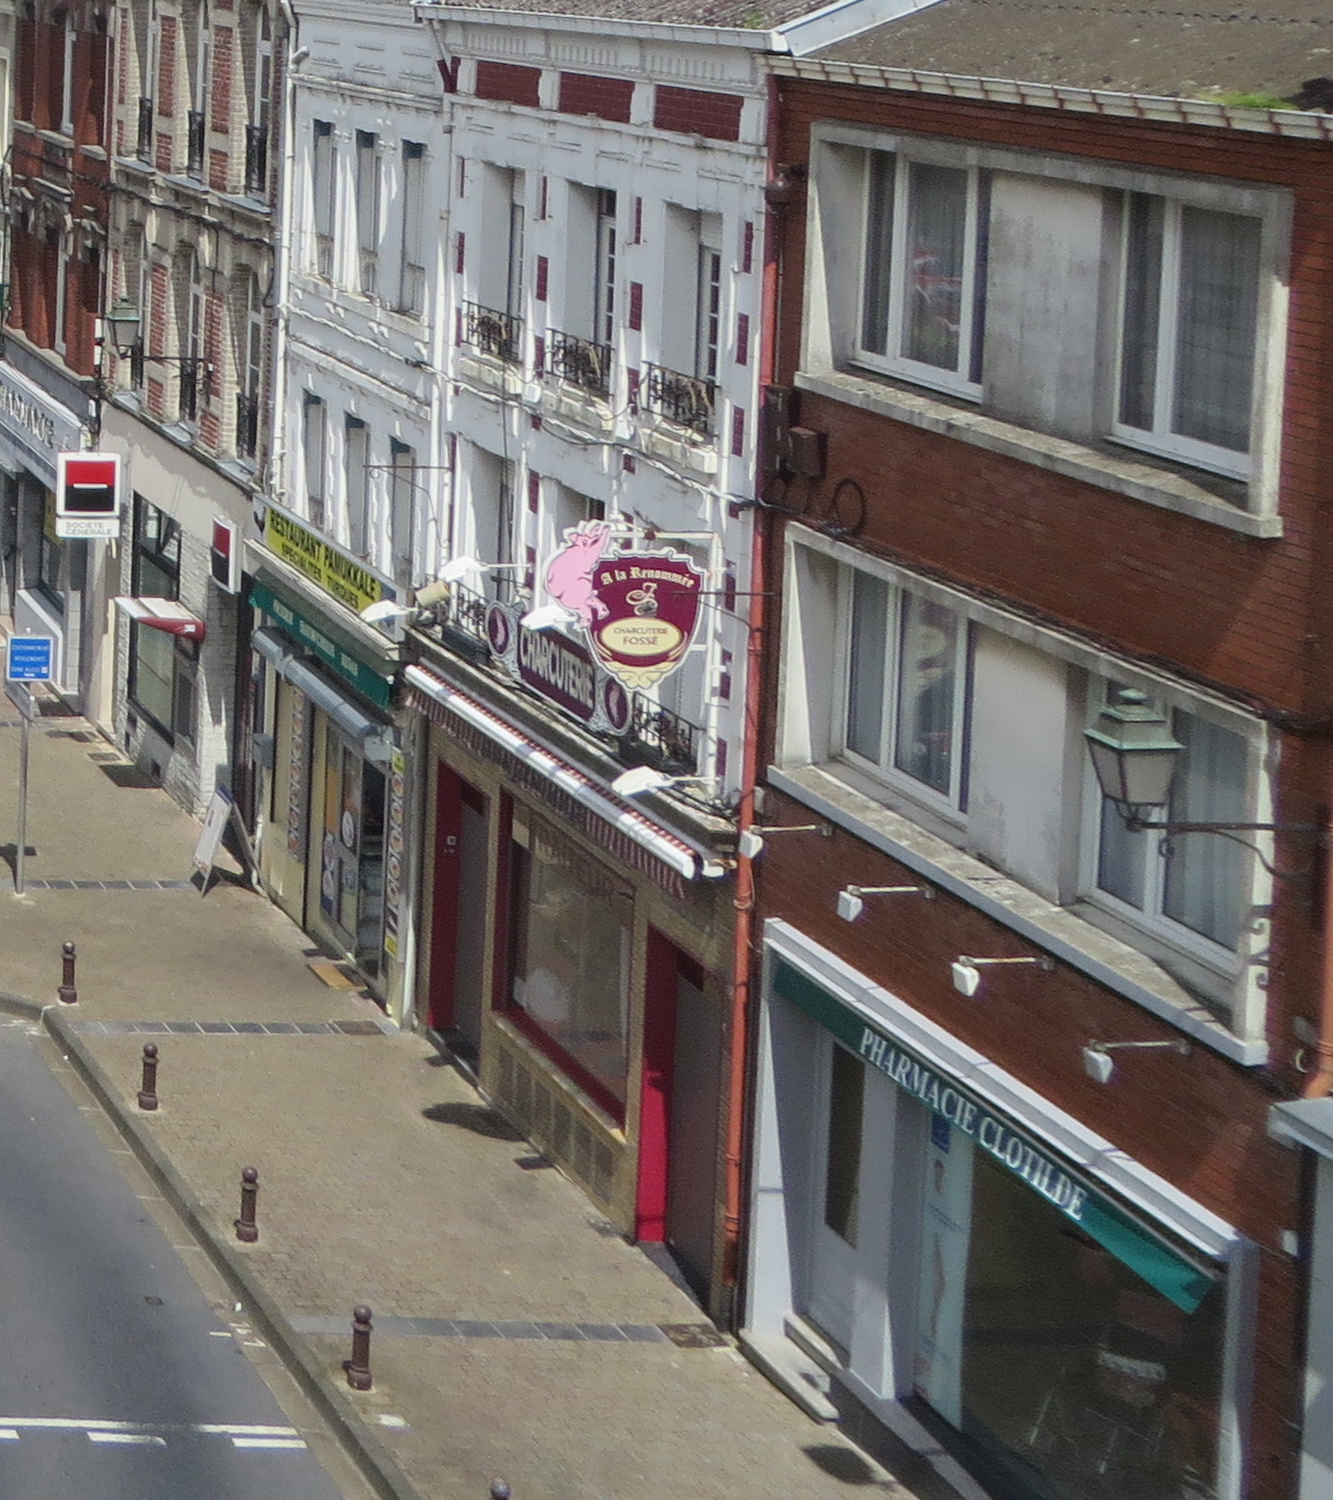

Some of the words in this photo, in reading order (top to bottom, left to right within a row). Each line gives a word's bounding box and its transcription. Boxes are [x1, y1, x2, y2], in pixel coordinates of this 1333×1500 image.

[270, 506, 322, 563] RESTAURANT
[613, 627, 668, 636] CHARCUTERIE
[520, 626, 595, 710] CHARCUTERIE
[860, 1027, 978, 1134] PHARMACIE
[979, 1116, 1088, 1222] CLOTILDE
